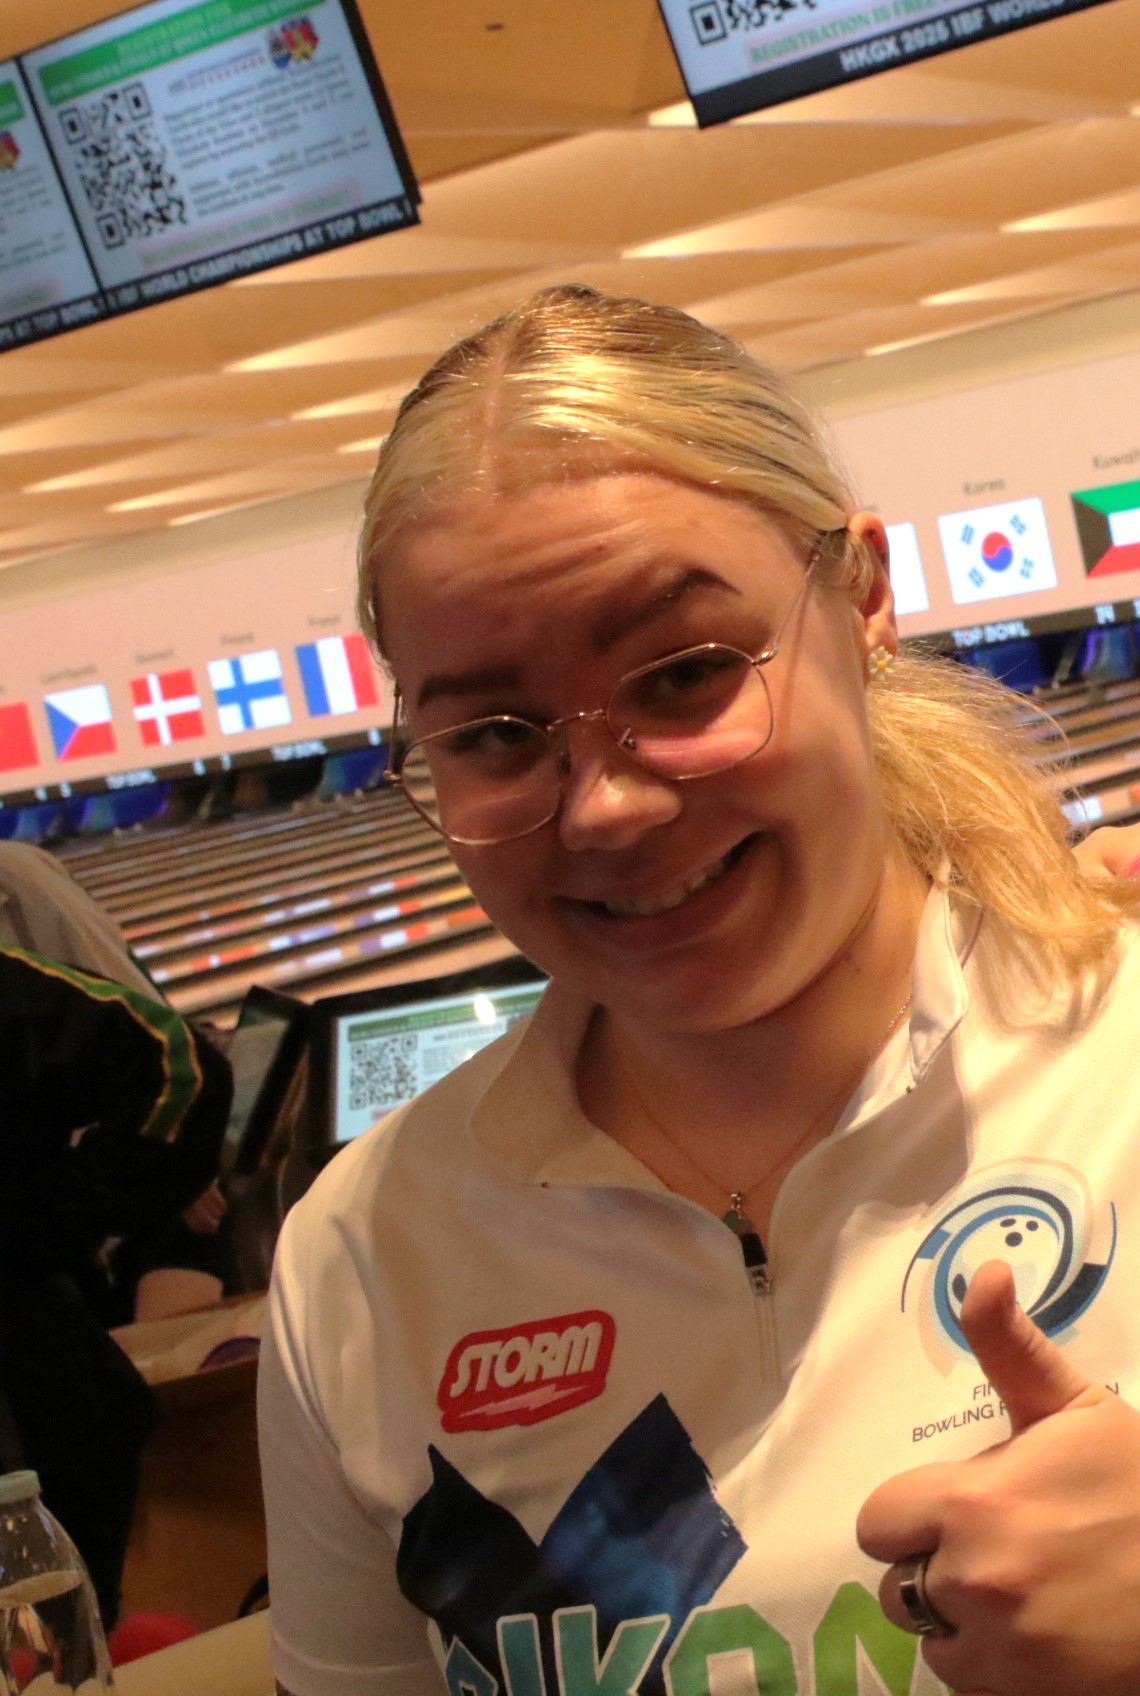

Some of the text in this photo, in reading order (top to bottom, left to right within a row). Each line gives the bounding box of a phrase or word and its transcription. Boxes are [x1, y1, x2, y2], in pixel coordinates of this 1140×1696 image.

[839, 40, 899, 72] HKGX
[899, 22, 948, 52] 2025
[950, 8, 988, 36] IBF
[953, 619, 1032, 648] TOP BOWL
[449, 1321, 604, 1399] STORM
[911, 1402, 995, 1443] BOWLING
